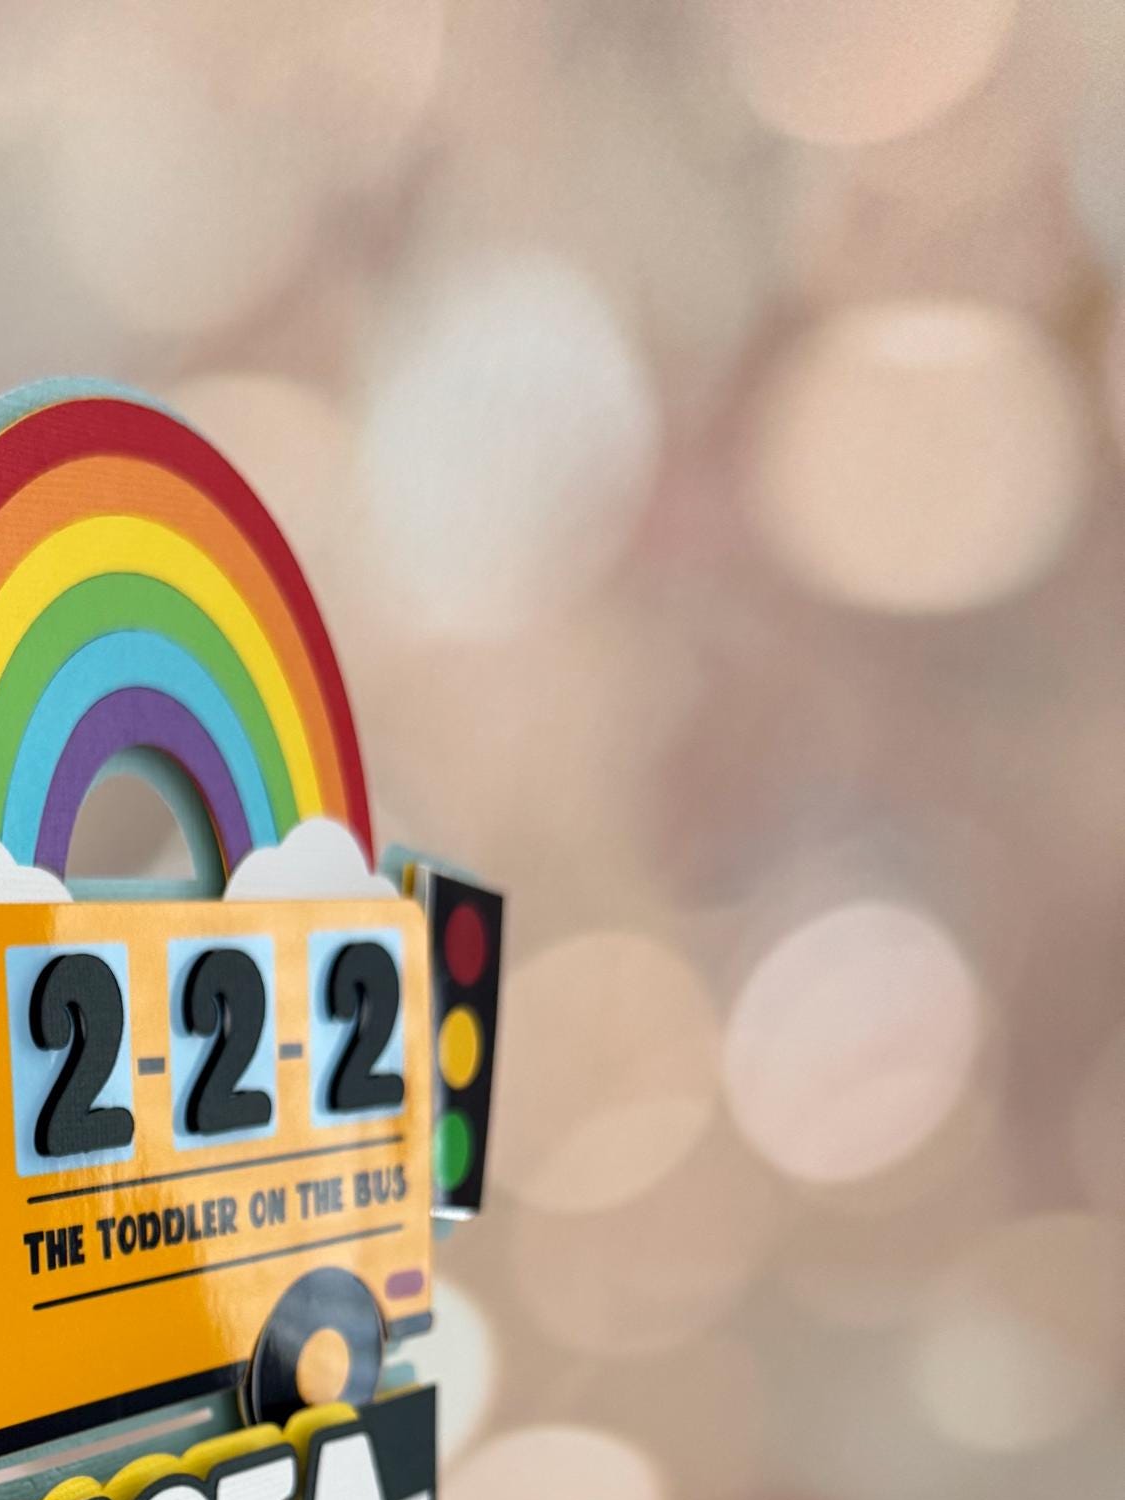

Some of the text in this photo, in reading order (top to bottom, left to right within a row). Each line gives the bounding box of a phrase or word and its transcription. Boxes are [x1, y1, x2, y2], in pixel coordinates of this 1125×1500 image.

[24, 1164, 408, 1275] THE TODDLER ON THE BUS
